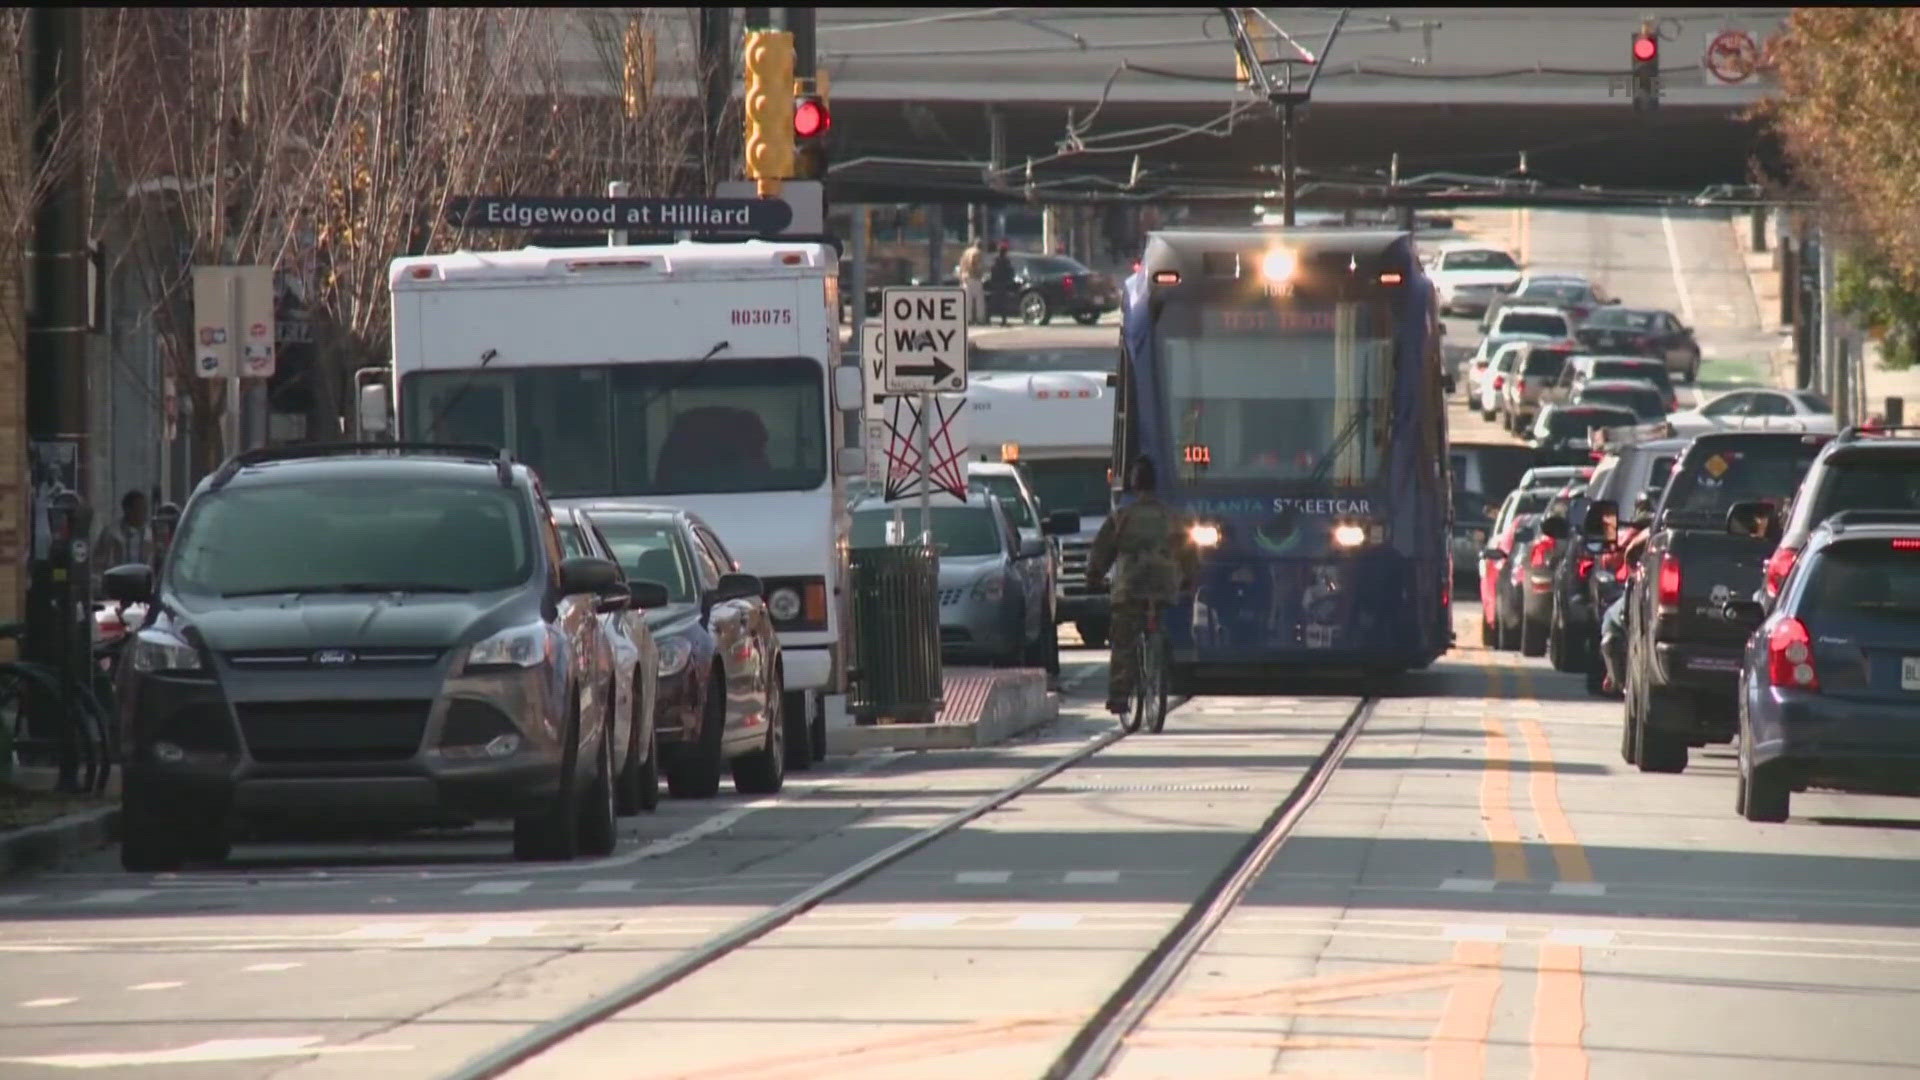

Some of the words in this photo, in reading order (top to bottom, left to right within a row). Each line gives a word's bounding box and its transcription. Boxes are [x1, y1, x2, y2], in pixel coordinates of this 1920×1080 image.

[487, 202, 616, 226] Edgewood
[627, 206, 650, 224] at
[661, 204, 750, 225] Hilliard
[894, 298, 957, 321] ONE
[894, 329, 956, 352] WAY
[1184, 446, 1210, 463] 101
[1184, 500, 1264, 514] ATLANTA
